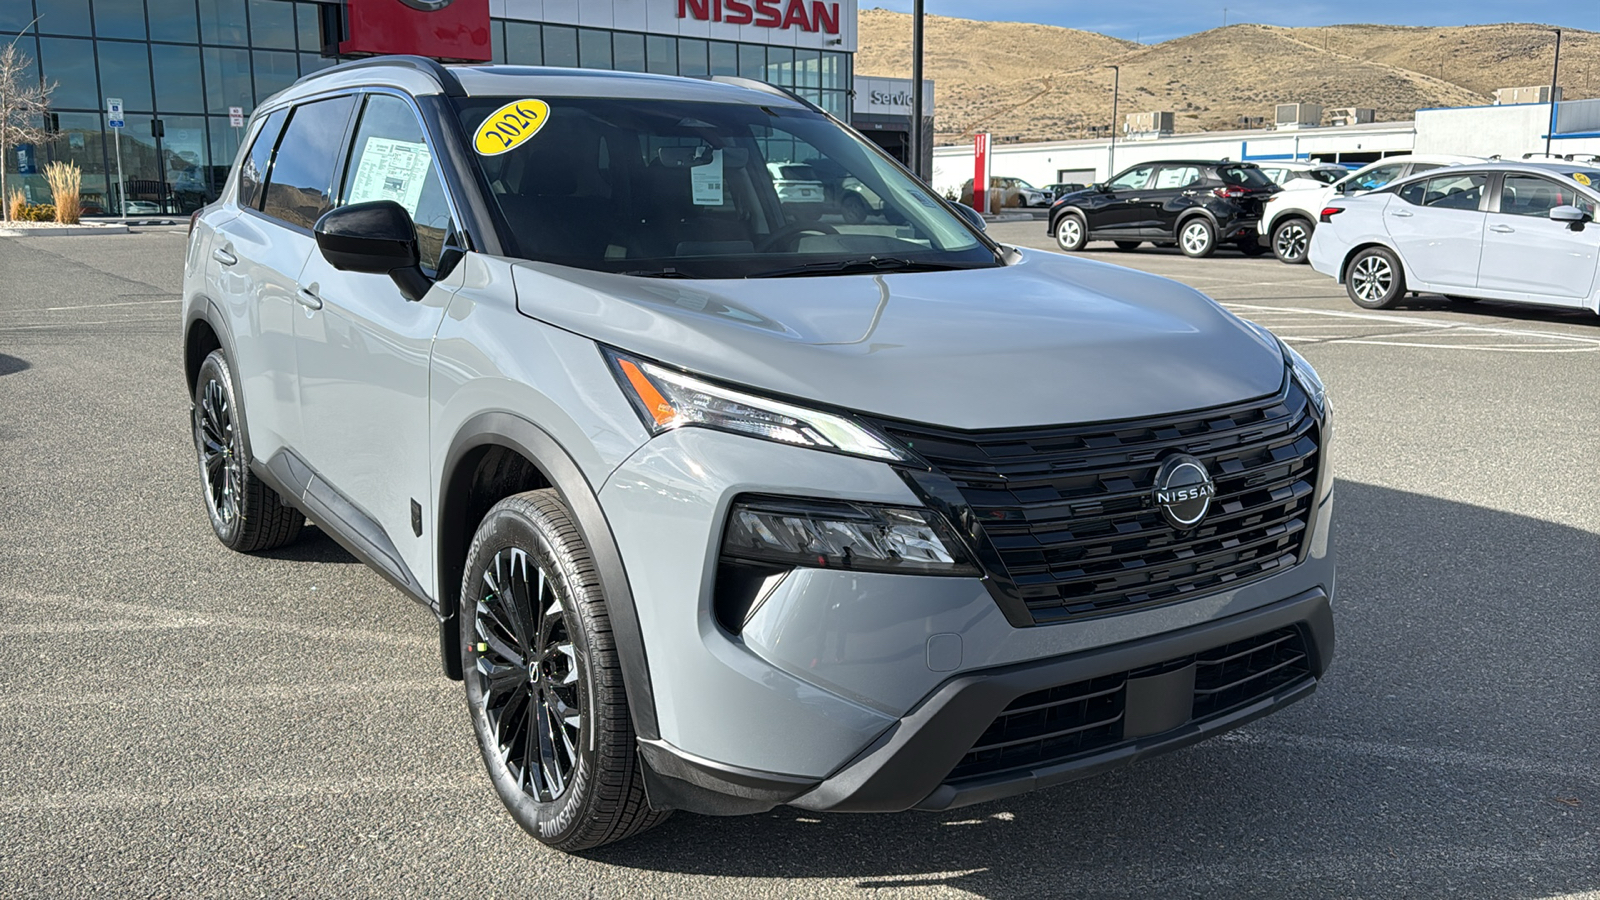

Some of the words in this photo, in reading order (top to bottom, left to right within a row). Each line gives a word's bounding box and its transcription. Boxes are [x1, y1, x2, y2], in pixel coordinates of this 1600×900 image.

[678, 0, 839, 34] NISSAN
[871, 89, 913, 106] Servic
[485, 104, 538, 148] 2026
[1157, 483, 1214, 503] NISSAN
